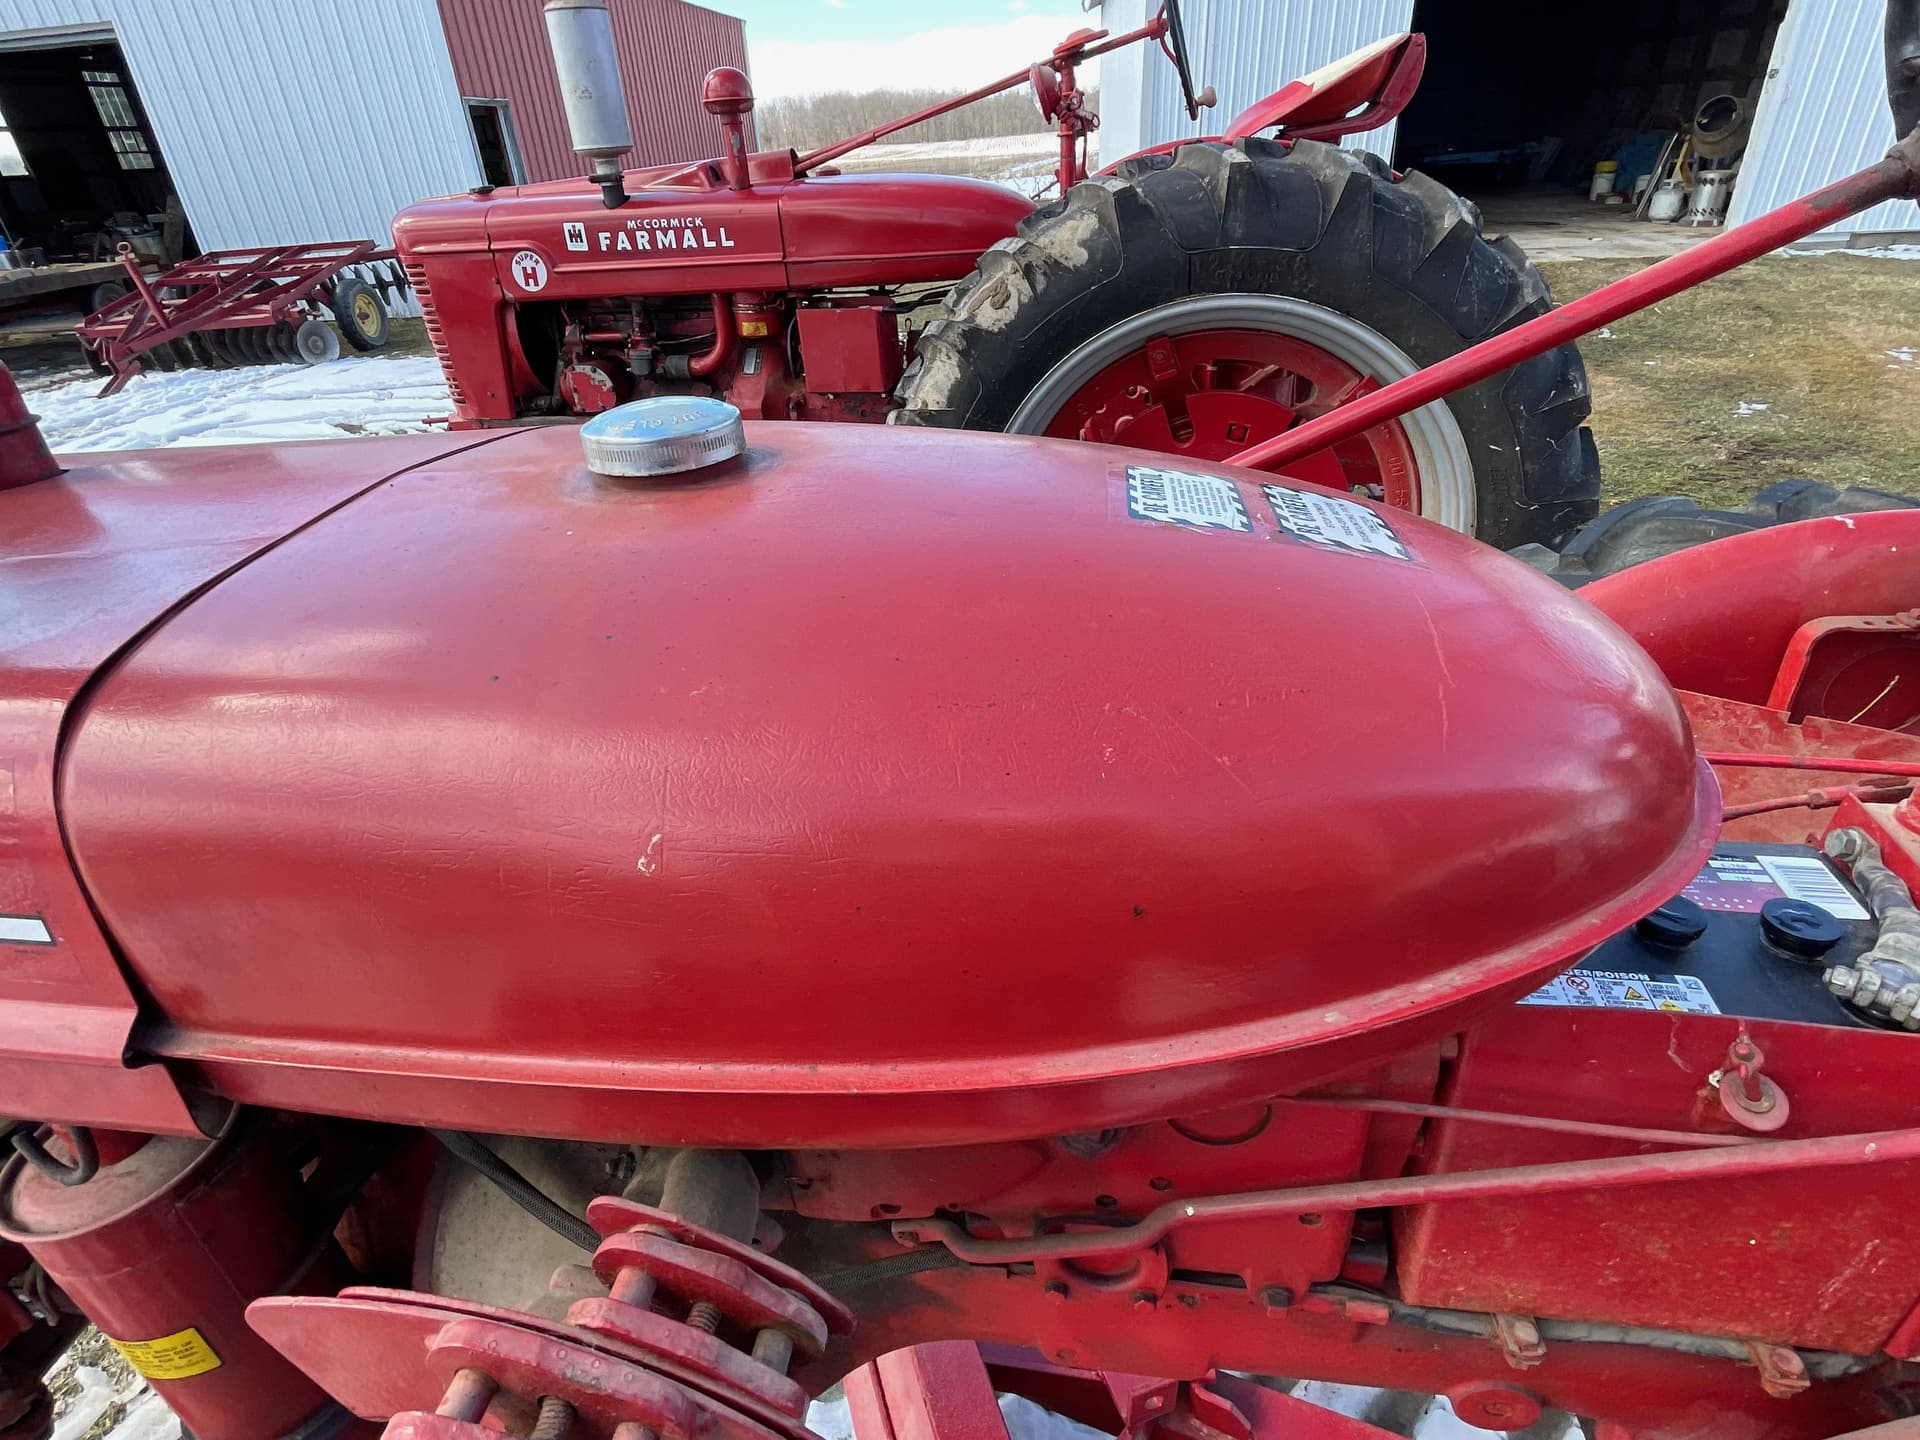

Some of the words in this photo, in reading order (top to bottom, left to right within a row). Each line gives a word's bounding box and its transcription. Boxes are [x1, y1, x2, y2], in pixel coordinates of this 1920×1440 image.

[627, 217, 704, 229] McCORMICK
[598, 227, 735, 251] FARMALL
[515, 253, 540, 266] SUPER
[522, 266, 540, 287] H
[1139, 472, 1167, 501] CAREFUL
[1143, 502, 1169, 514] BE
[1277, 491, 1317, 522] CAREFUL
[1293, 522, 1324, 536] BE
